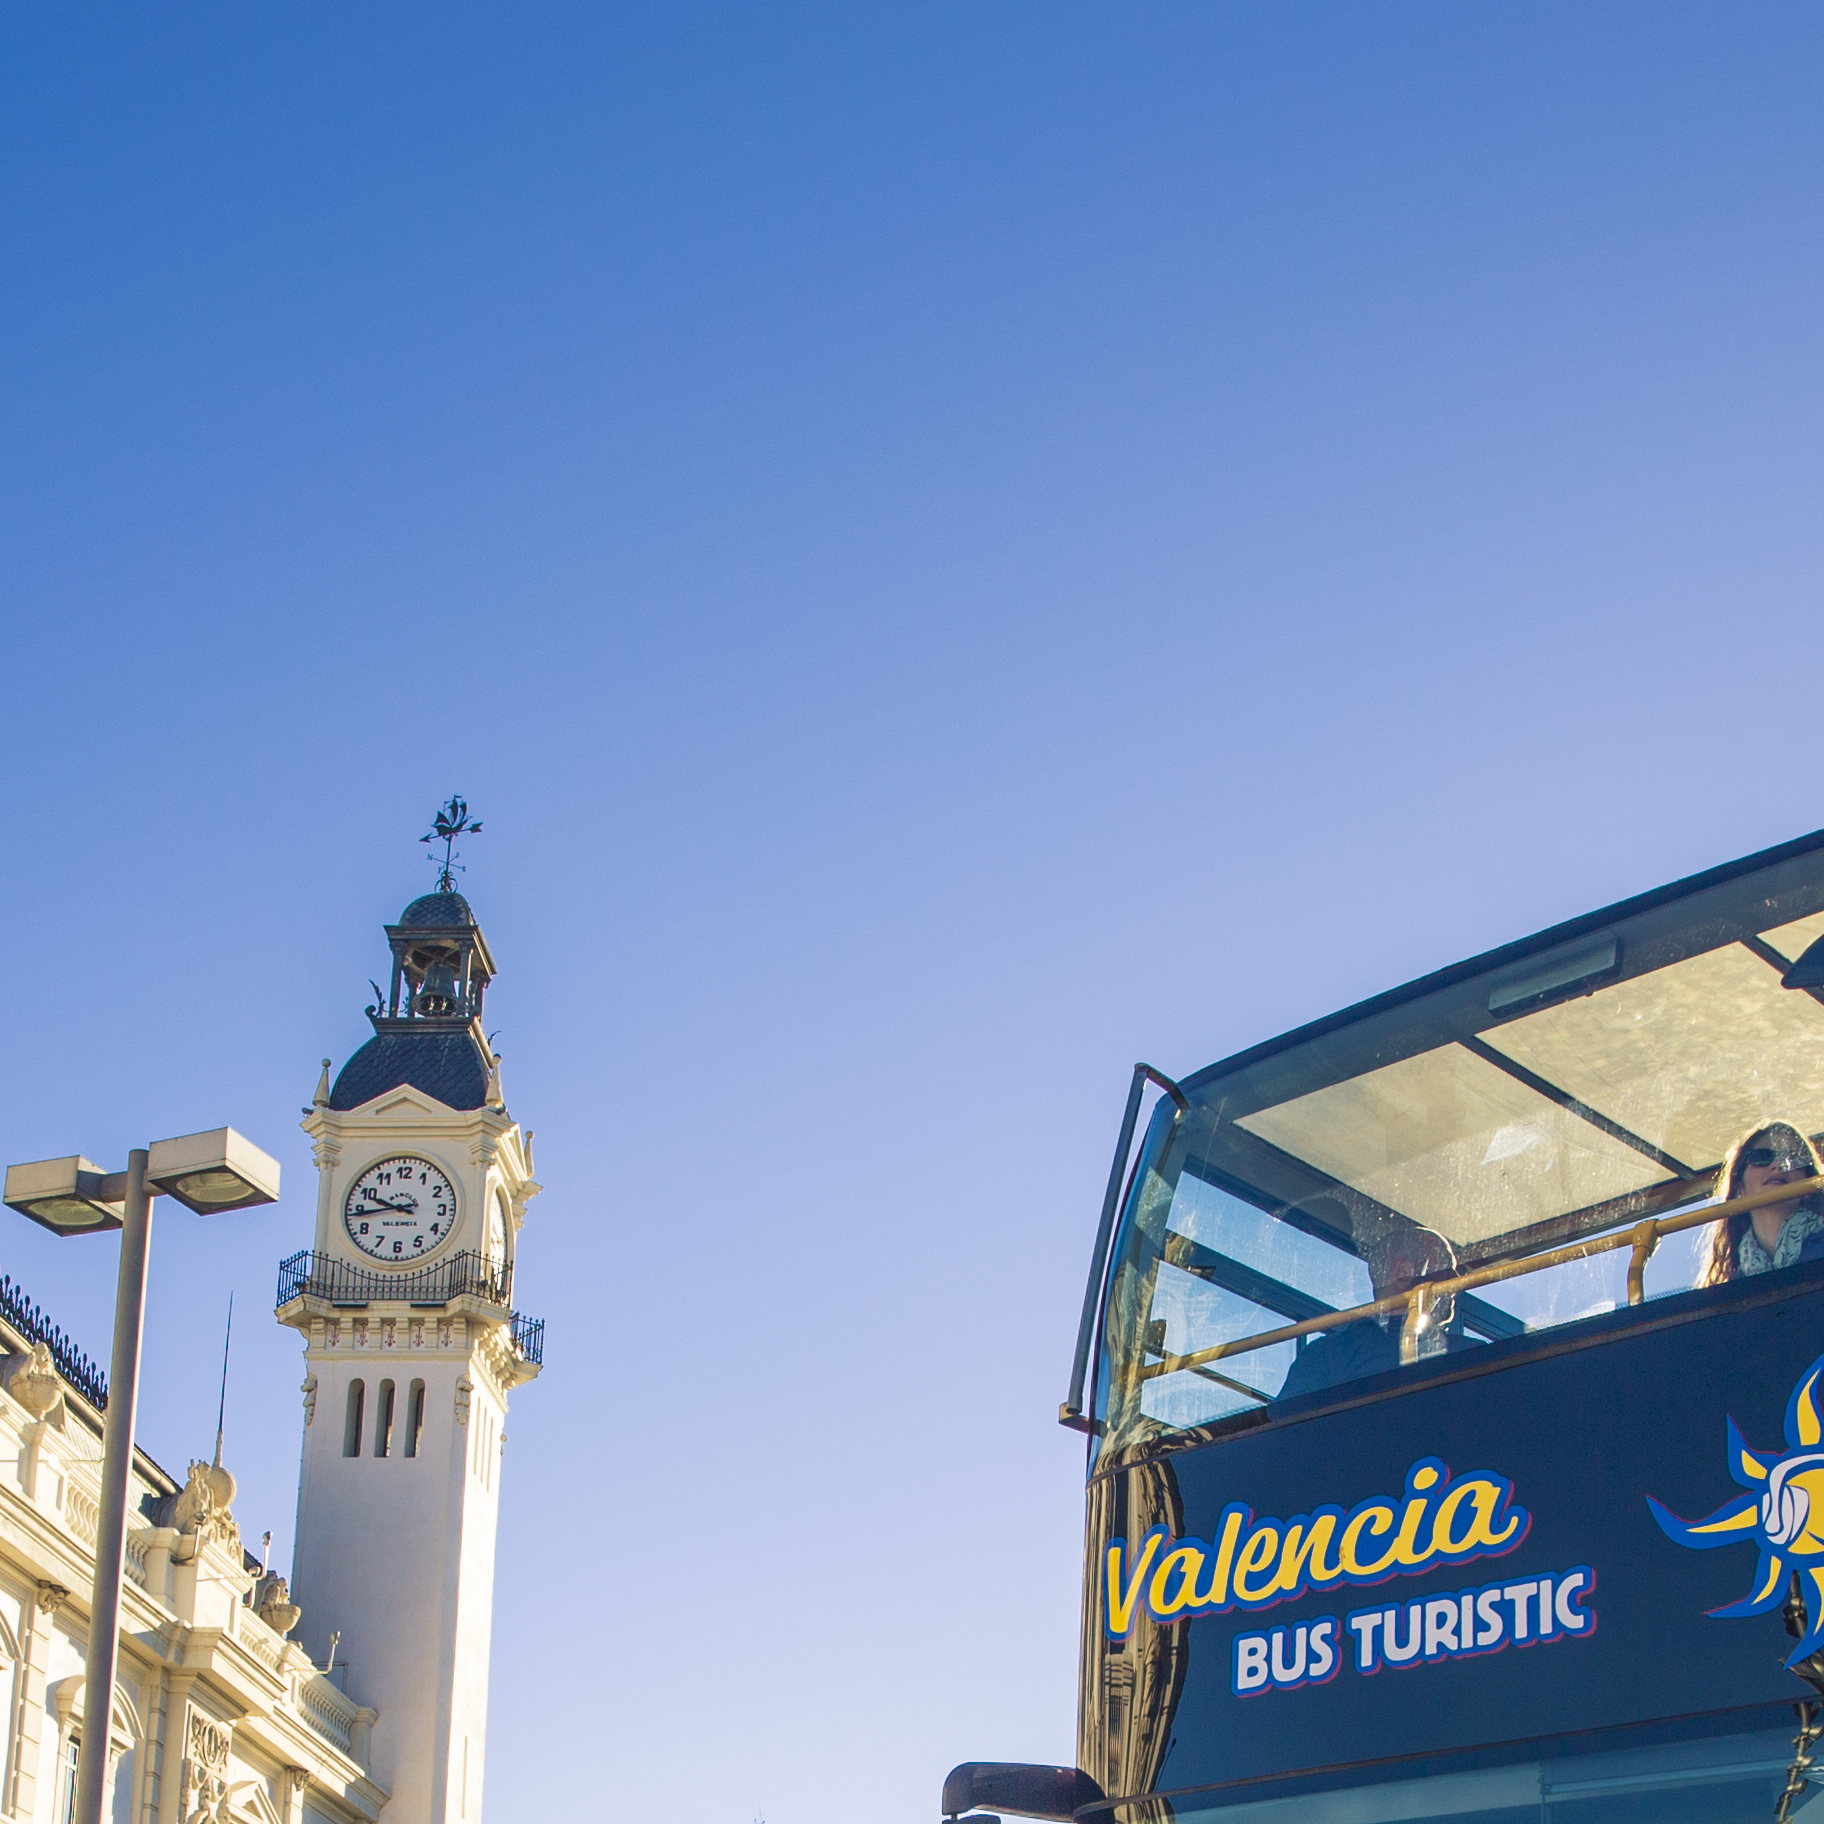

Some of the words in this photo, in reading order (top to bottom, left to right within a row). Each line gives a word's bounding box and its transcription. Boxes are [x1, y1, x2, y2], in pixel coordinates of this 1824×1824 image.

[376, 1172, 392, 1185] 11
[396, 1166, 413, 1179] 12
[419, 1173, 427, 1185] 1
[360, 1187, 378, 1200] 10
[432, 1185, 442, 1198] 2
[437, 1204, 447, 1216] 3
[359, 1222, 370, 1235] 8
[430, 1222, 439, 1235] 4
[374, 1235, 385, 1248] 7
[393, 1241, 403, 1253] 6
[413, 1235, 424, 1248] 5
[1104, 1463, 1521, 1634] Valencia
[1236, 1614, 1334, 1692] BUS
[1350, 1573, 1590, 1667] TURISTIC
